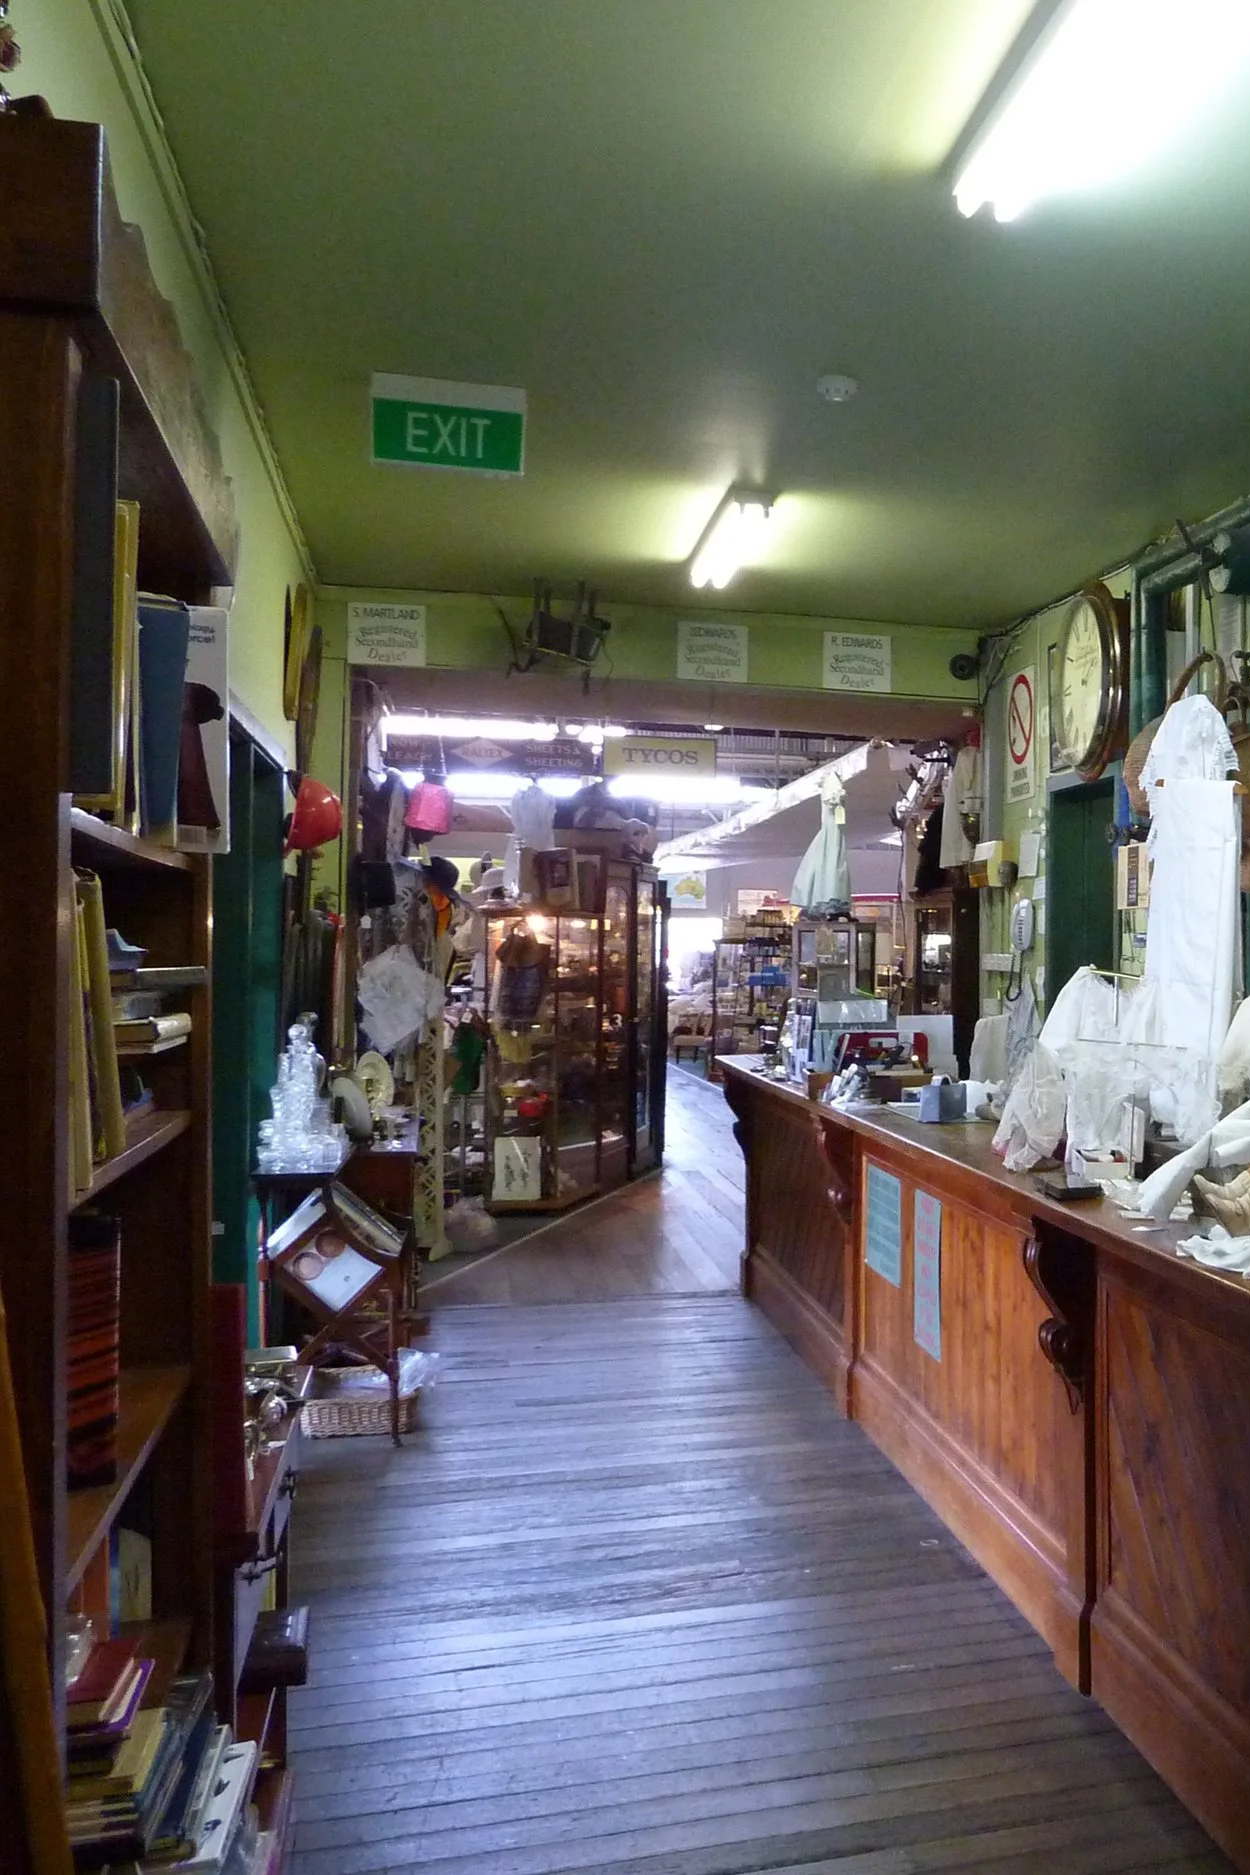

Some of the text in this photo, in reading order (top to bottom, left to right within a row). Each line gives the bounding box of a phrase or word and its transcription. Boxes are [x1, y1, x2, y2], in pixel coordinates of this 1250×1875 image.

[406, 411, 491, 459] EXIT
[363, 608, 420, 620] MARTLAND
[842, 636, 883, 649] EDWARDS
[367, 647, 407, 663] Dealer
[841, 674, 874, 689] Dealer
[525, 756, 583, 768] SHEETING
[623, 747, 698, 765] TYCOS
